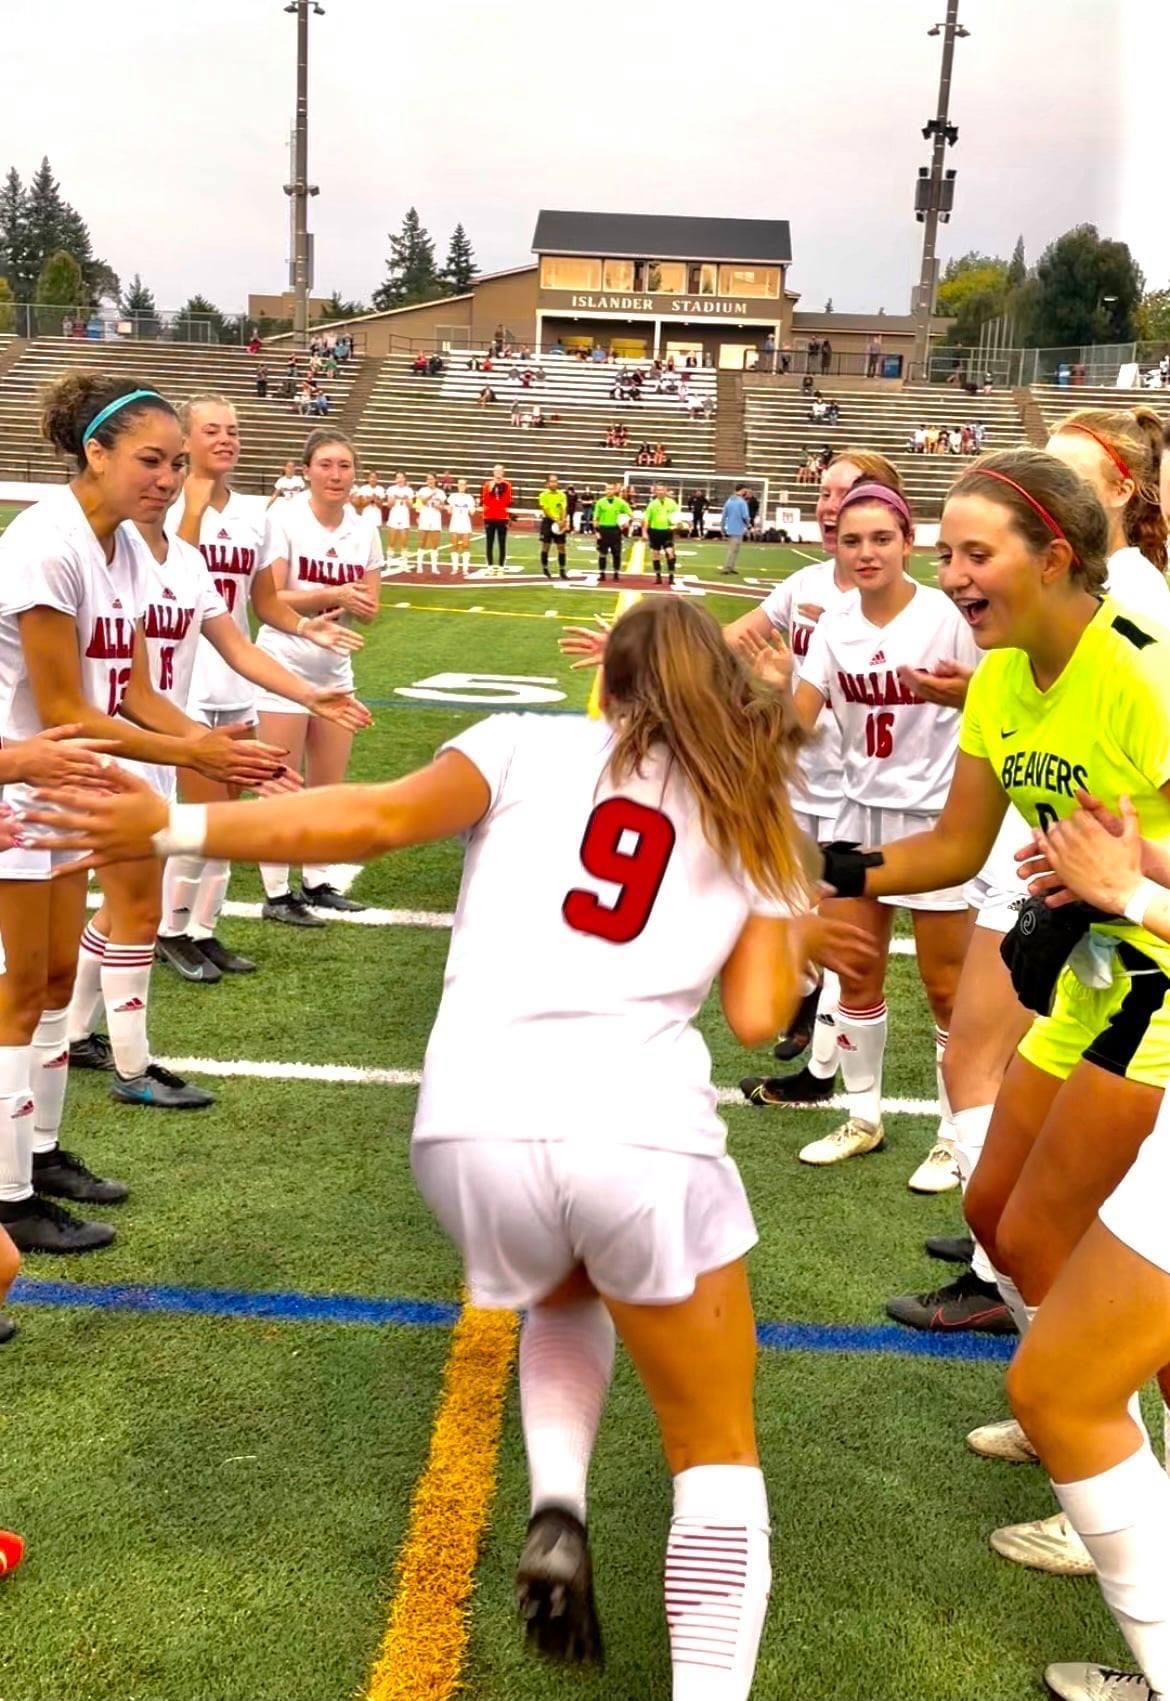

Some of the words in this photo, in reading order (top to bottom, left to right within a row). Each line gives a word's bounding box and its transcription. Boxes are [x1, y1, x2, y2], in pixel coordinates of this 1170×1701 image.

[572, 295, 653, 310] ISLANDER
[671, 300, 747, 314] STADIUM
[866, 712, 895, 759] 16
[1002, 751, 1089, 798] BEAVERS
[562, 796, 676, 945] 9
